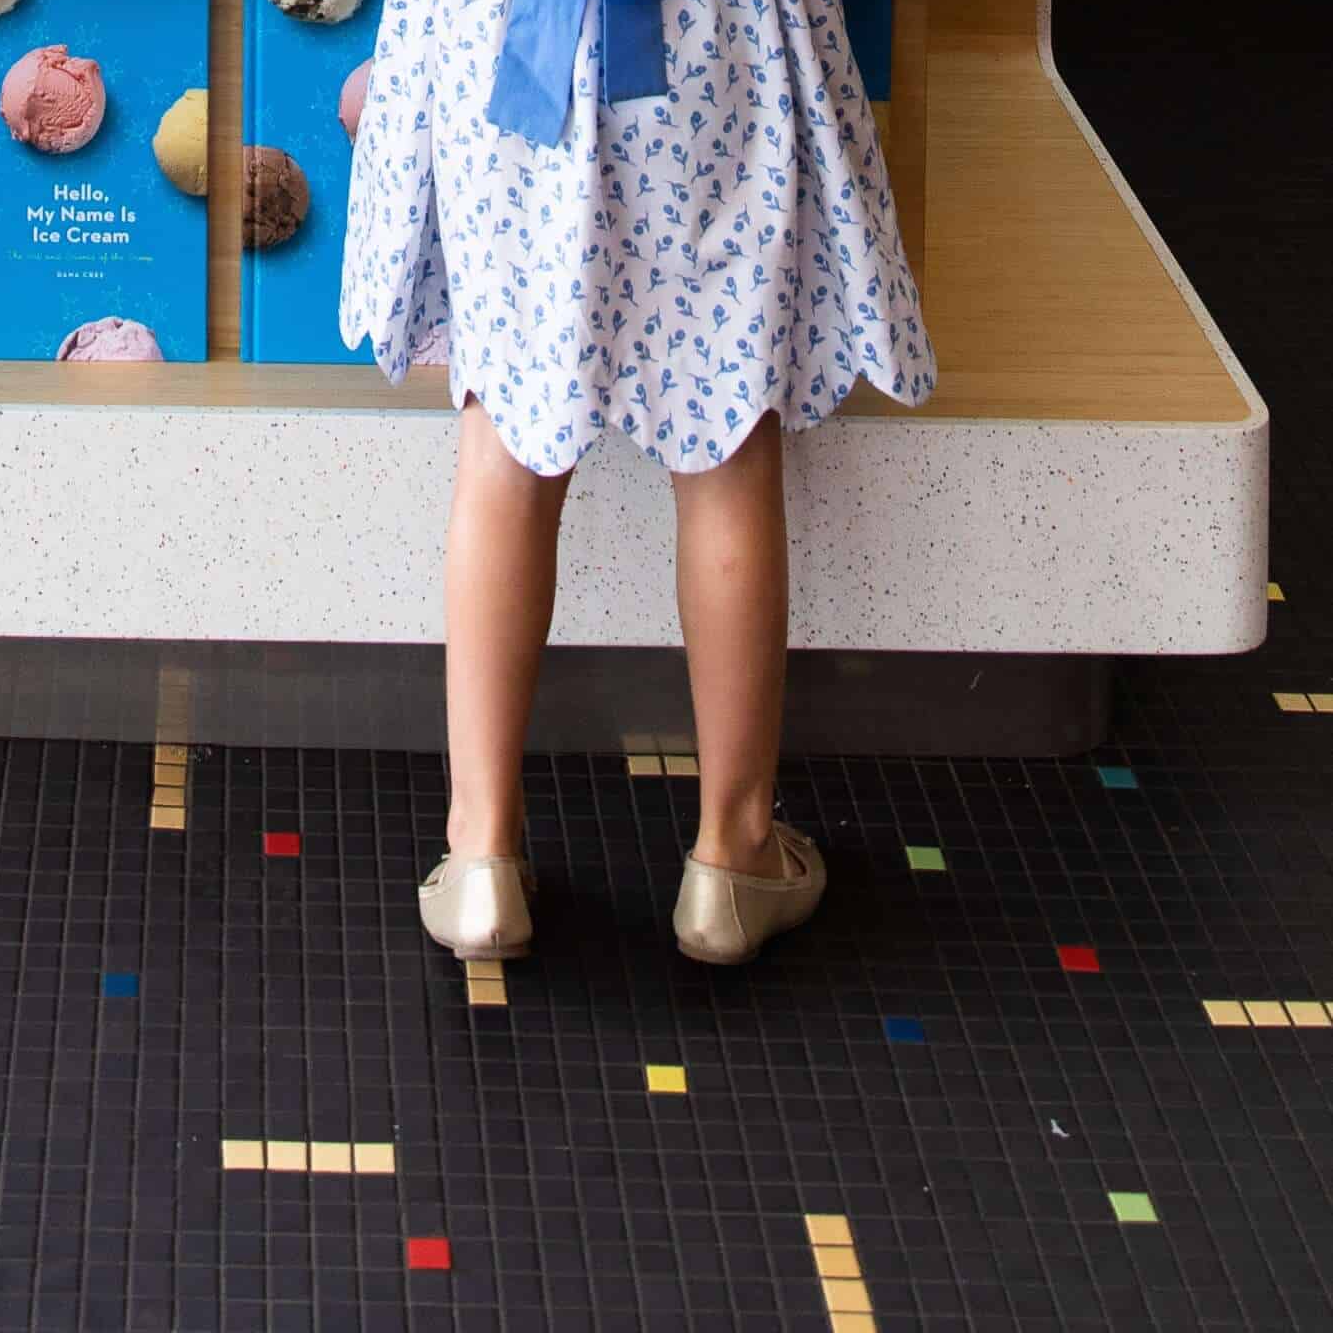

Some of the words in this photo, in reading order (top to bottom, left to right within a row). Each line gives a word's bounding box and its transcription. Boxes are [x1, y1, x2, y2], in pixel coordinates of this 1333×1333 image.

[53, 183, 110, 204] Hello,
[26, 205, 55, 227] My
[60, 205, 115, 223] Name
[120, 205, 137, 223] Is
[33, 225, 61, 244] Ice
[66, 226, 130, 245] Cream
